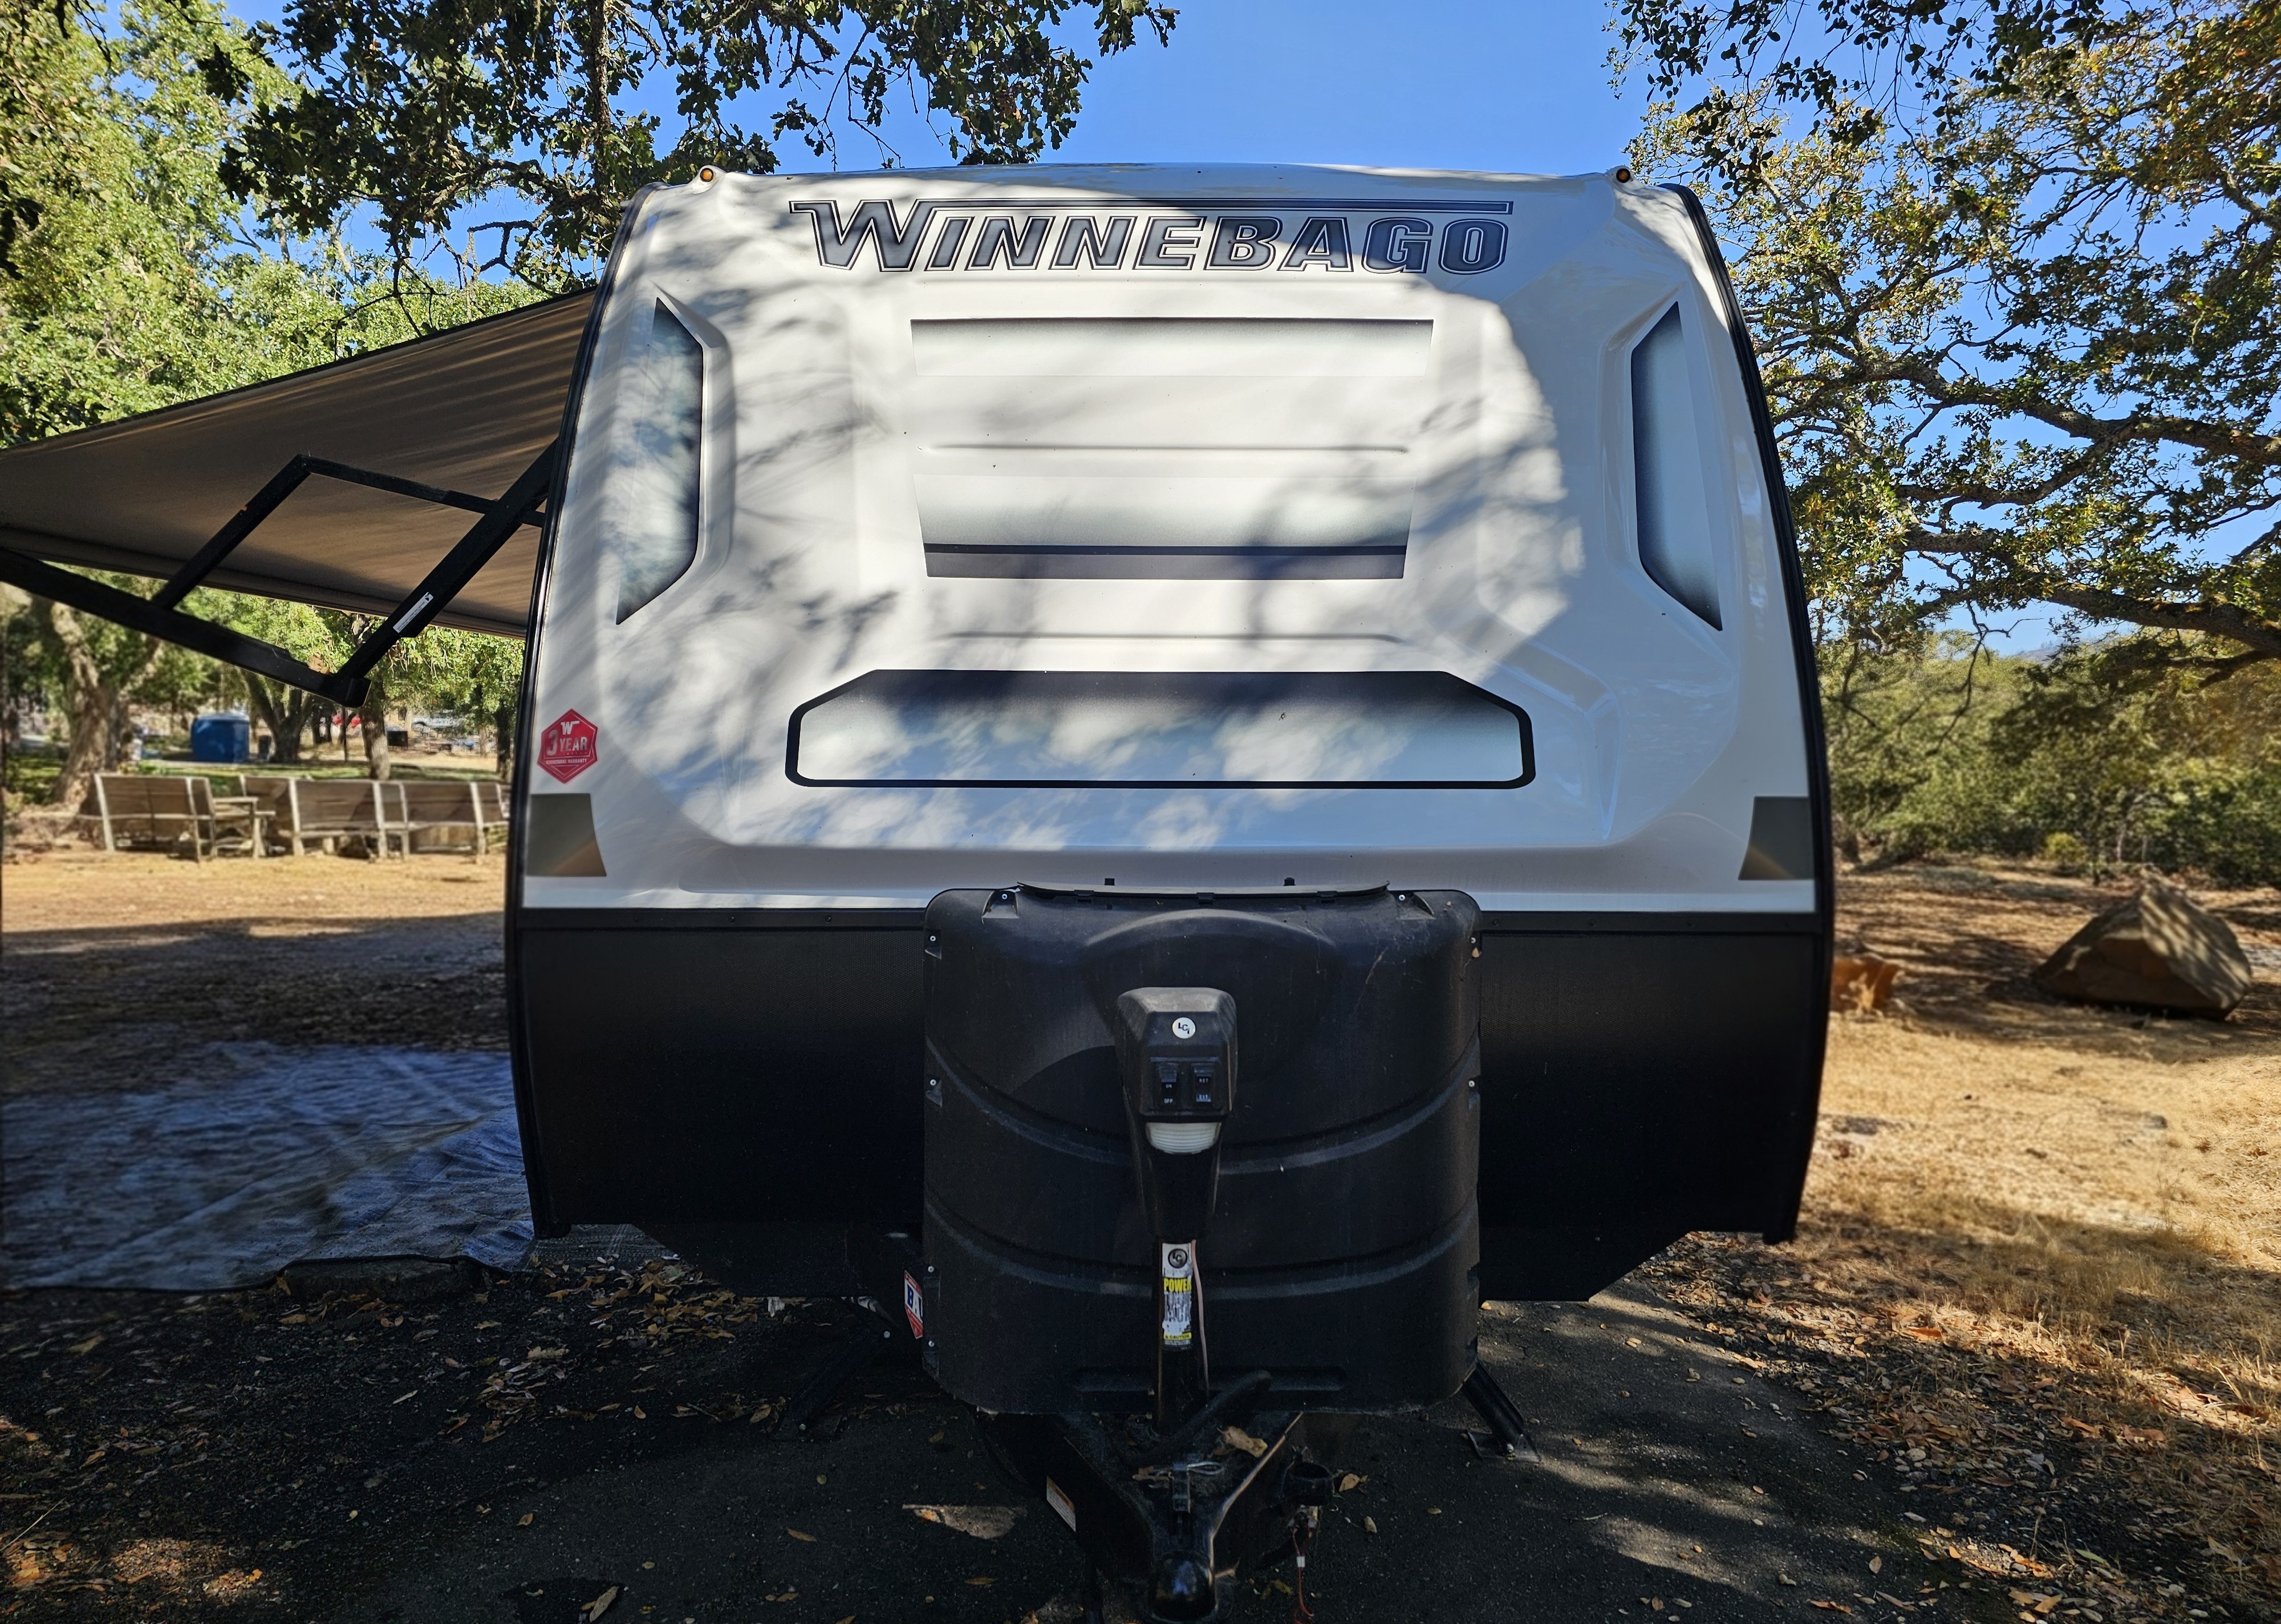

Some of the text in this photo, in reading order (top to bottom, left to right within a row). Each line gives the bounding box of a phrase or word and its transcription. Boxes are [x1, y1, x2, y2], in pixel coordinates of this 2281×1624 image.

[789, 199, 1513, 275] WINNEBAGO
[546, 729, 588, 756] 3 YEAR
[1164, 1278, 1192, 1292] POWER
